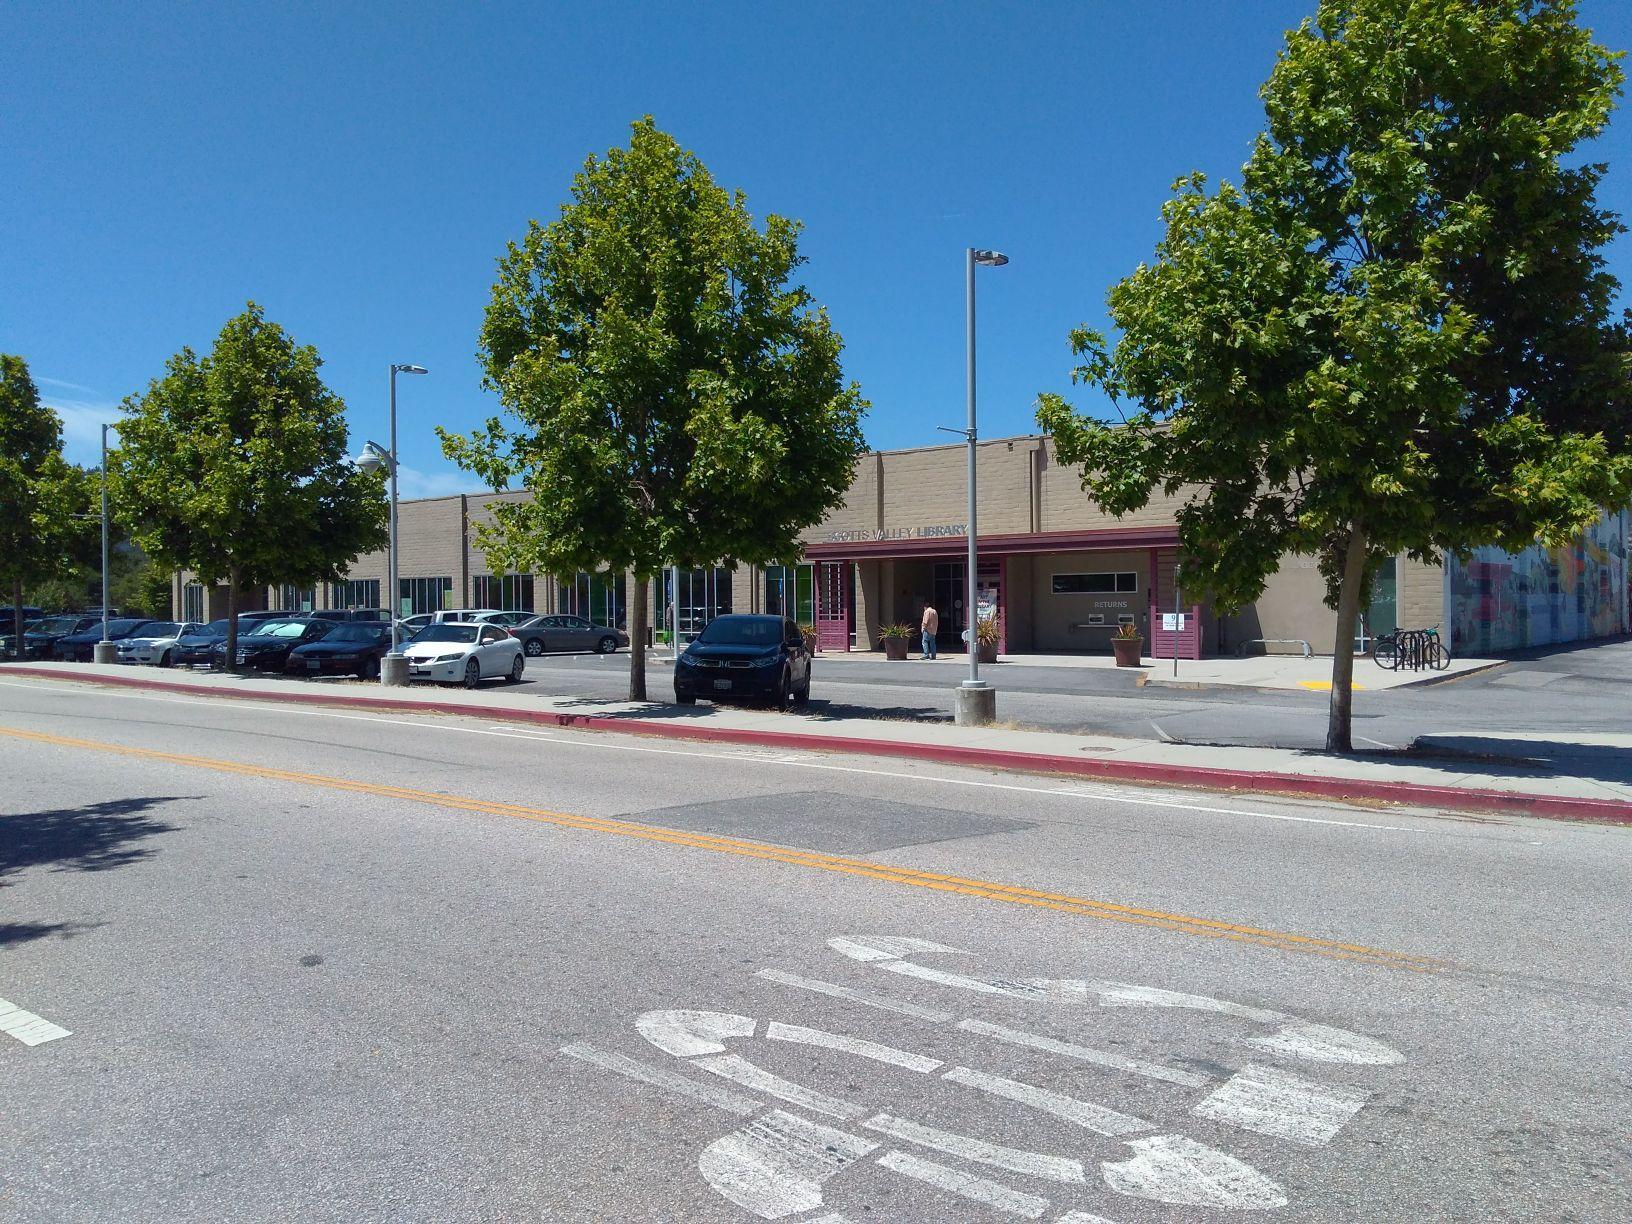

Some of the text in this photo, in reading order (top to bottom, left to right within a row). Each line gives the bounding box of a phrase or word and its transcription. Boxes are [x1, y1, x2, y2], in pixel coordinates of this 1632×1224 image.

[829, 524, 968, 542] SCOTTS VALLEY LIBRARY
